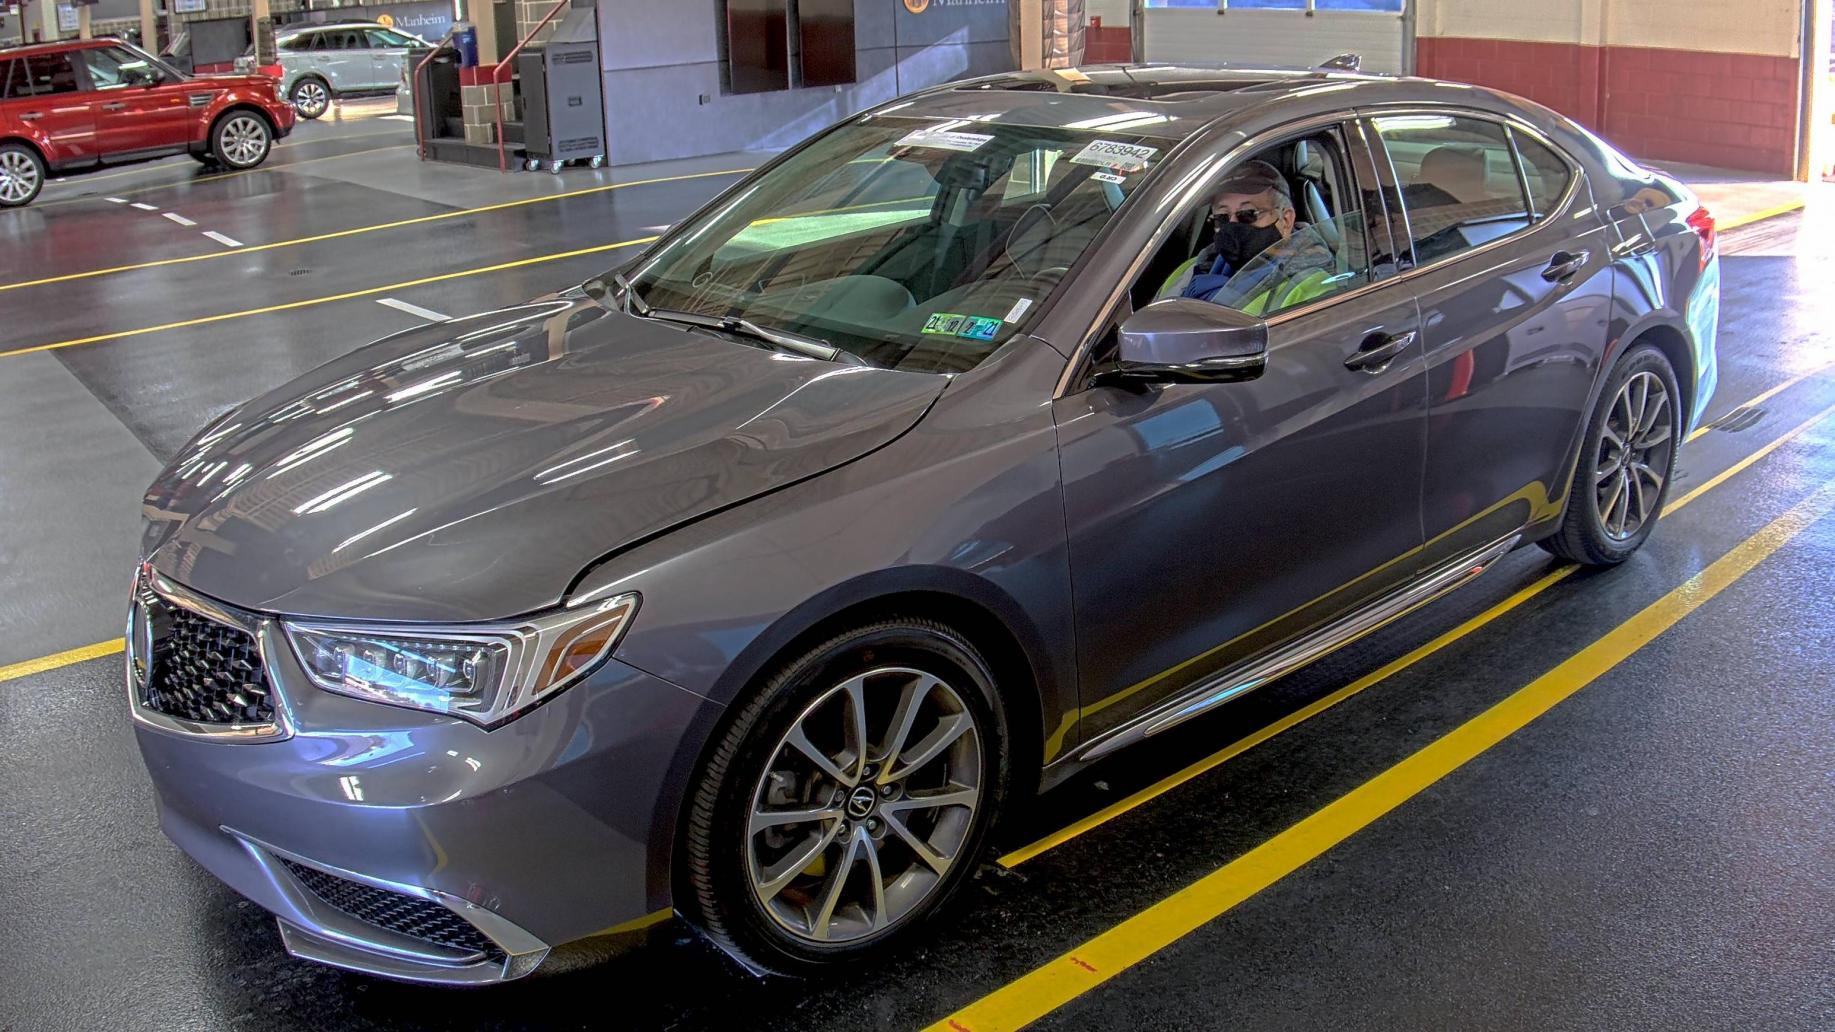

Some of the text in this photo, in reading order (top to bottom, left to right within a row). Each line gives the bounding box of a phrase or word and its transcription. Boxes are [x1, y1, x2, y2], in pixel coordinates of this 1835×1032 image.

[395, 14, 445, 27] Manheim
[1089, 142, 1150, 159] 6783942
[926, 316, 940, 330] 21
[983, 321, 998, 336] 21
